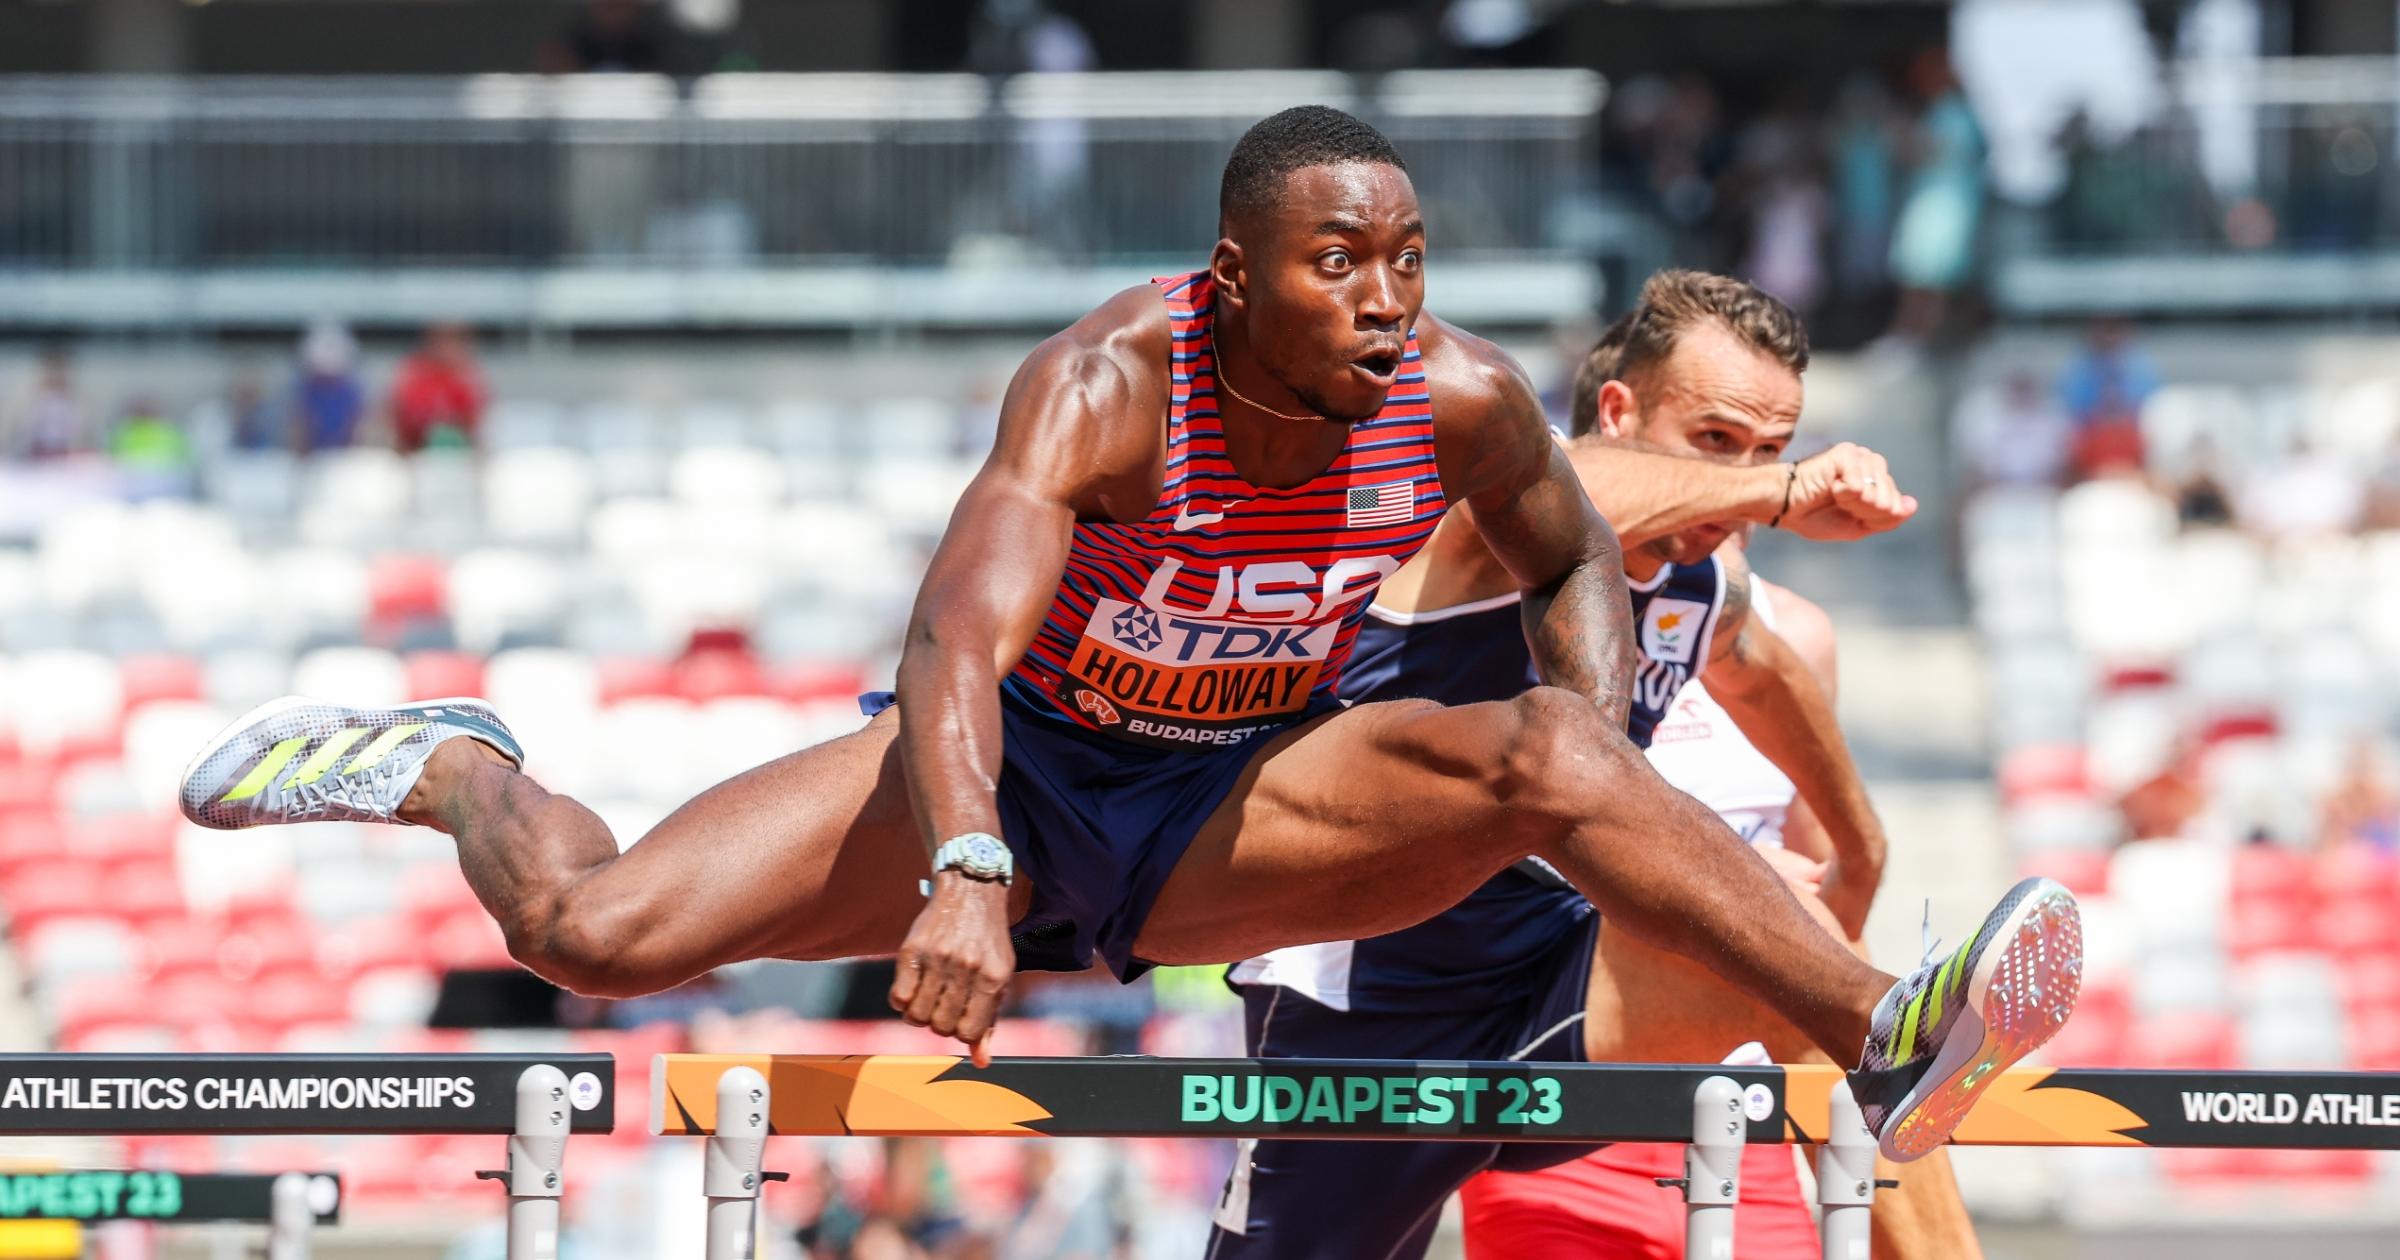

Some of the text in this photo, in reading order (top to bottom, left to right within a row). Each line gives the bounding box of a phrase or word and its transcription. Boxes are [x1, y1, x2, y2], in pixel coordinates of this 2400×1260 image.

[1168, 617, 1319, 661] TDK
[1082, 647, 1310, 715] HOLLOWAY
[1127, 719, 1255, 745] BUDAPEST
[1, 1076, 475, 1110] ATHLETICS CHAMPIONSHIPS
[1181, 1075, 1563, 1125] BUDAPEST 23
[2181, 1091, 2400, 1126] WORLD ATHLE
[126, 1171, 183, 1217] 23
